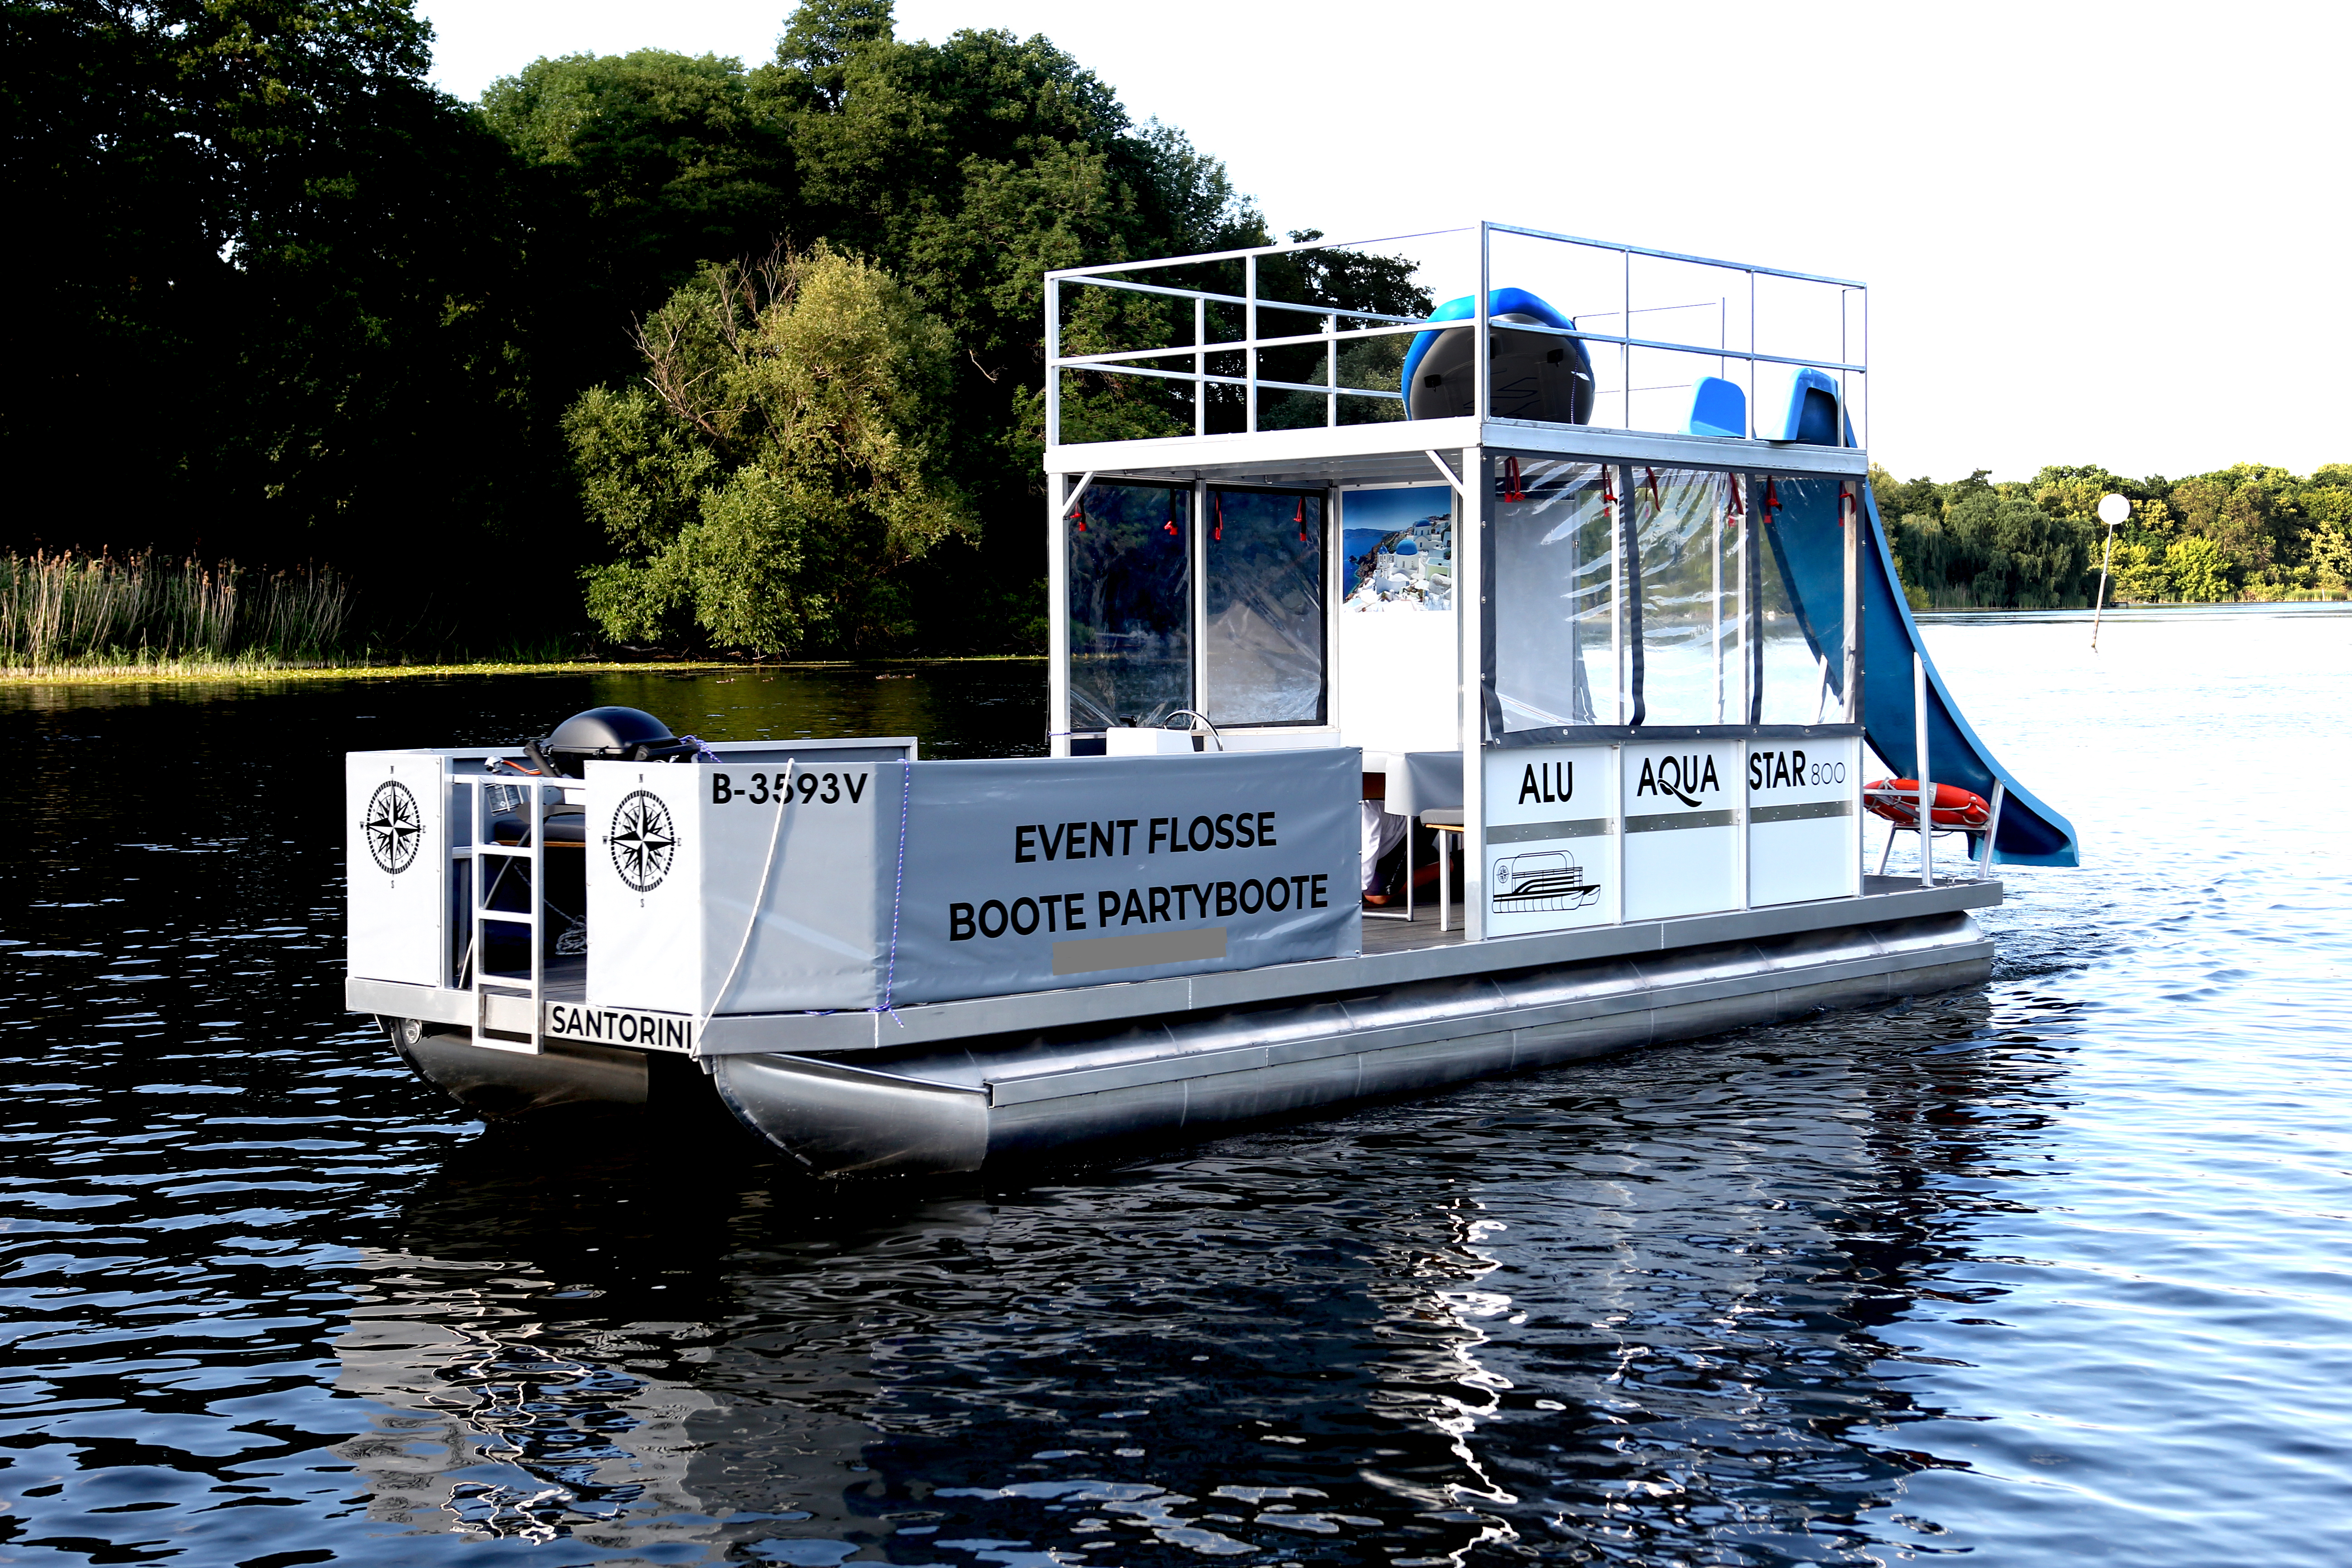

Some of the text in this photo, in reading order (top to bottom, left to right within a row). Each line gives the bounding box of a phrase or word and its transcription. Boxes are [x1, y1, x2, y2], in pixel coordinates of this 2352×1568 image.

[713, 773, 868, 804] B-3593V
[1519, 750, 1846, 808] ALU AQUA STAR 800
[1015, 811, 1277, 863] EVENT FLOSSE
[950, 873, 1328, 941] BOOTE PARTYBOOTE
[552, 1006, 692, 1049] SANTORINI
